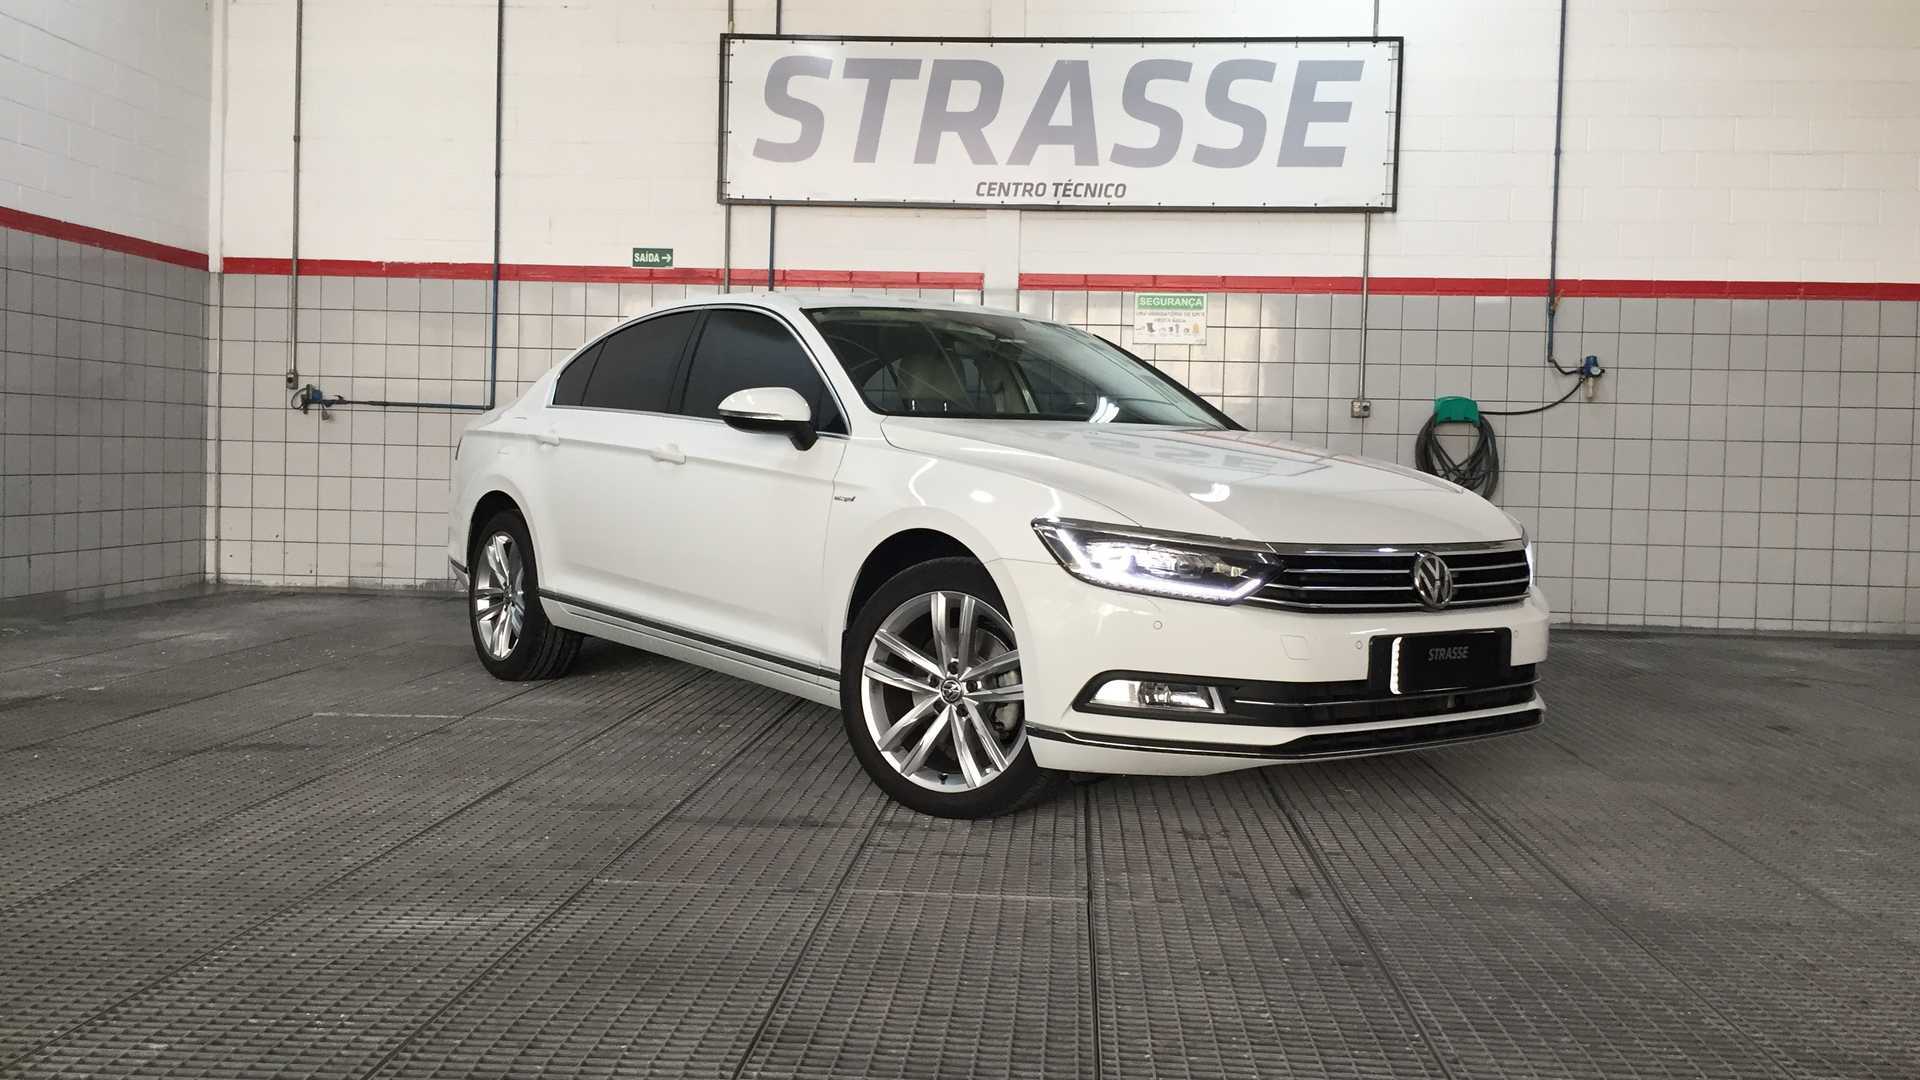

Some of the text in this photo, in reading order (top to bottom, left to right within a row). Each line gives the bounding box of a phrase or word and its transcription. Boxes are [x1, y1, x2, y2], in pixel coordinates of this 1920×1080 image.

[752, 55, 1365, 169] STRASSE
[975, 179, 1127, 198] CENTRO TÉCNICO
[634, 251, 660, 262] SAÍDA
[1140, 297, 1202, 308] SEGURANÇA
[1428, 646, 1469, 661] STRASSE
